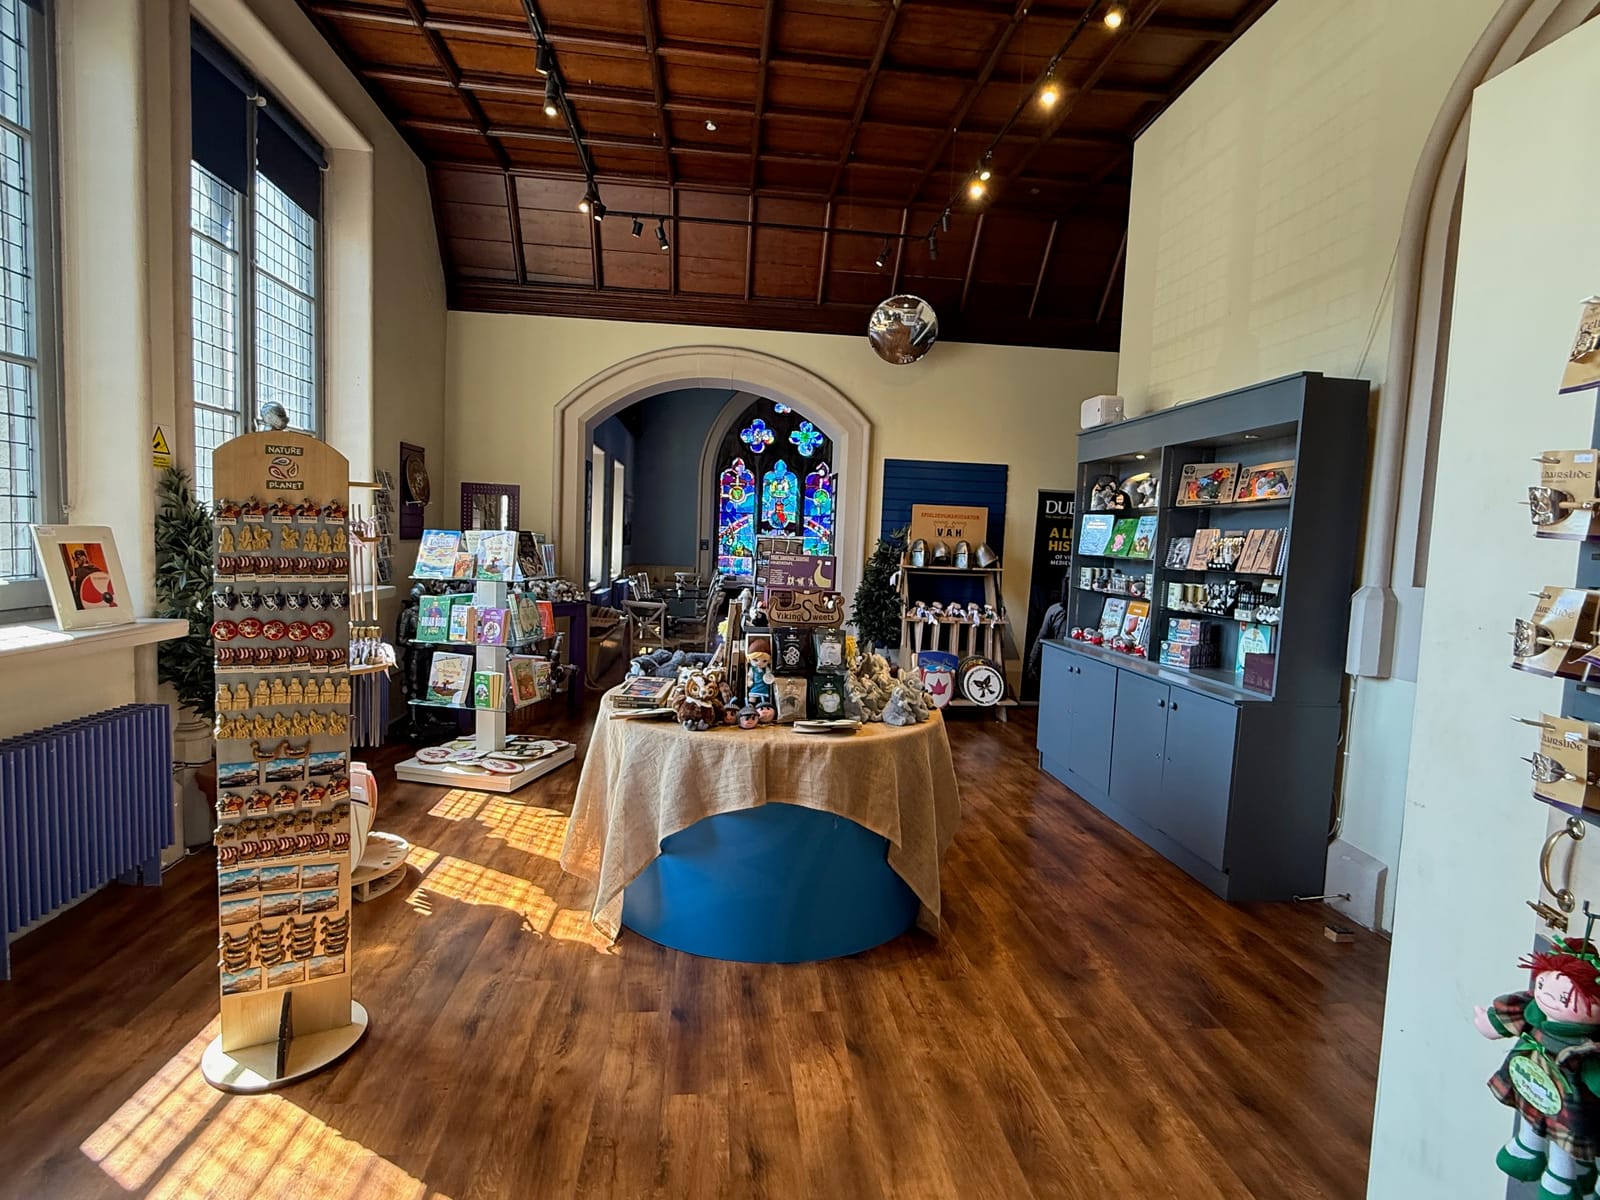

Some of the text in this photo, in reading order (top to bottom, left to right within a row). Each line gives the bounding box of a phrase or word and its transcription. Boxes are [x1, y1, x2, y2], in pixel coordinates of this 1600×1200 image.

[267, 446, 302, 456] NATURE
[268, 481, 302, 490] PLANET
[936, 527, 962, 537] VAH
[1049, 528, 1059, 538] A
[1048, 541, 1072, 551] HIS
[775, 598, 835, 622] Viking Sweets
